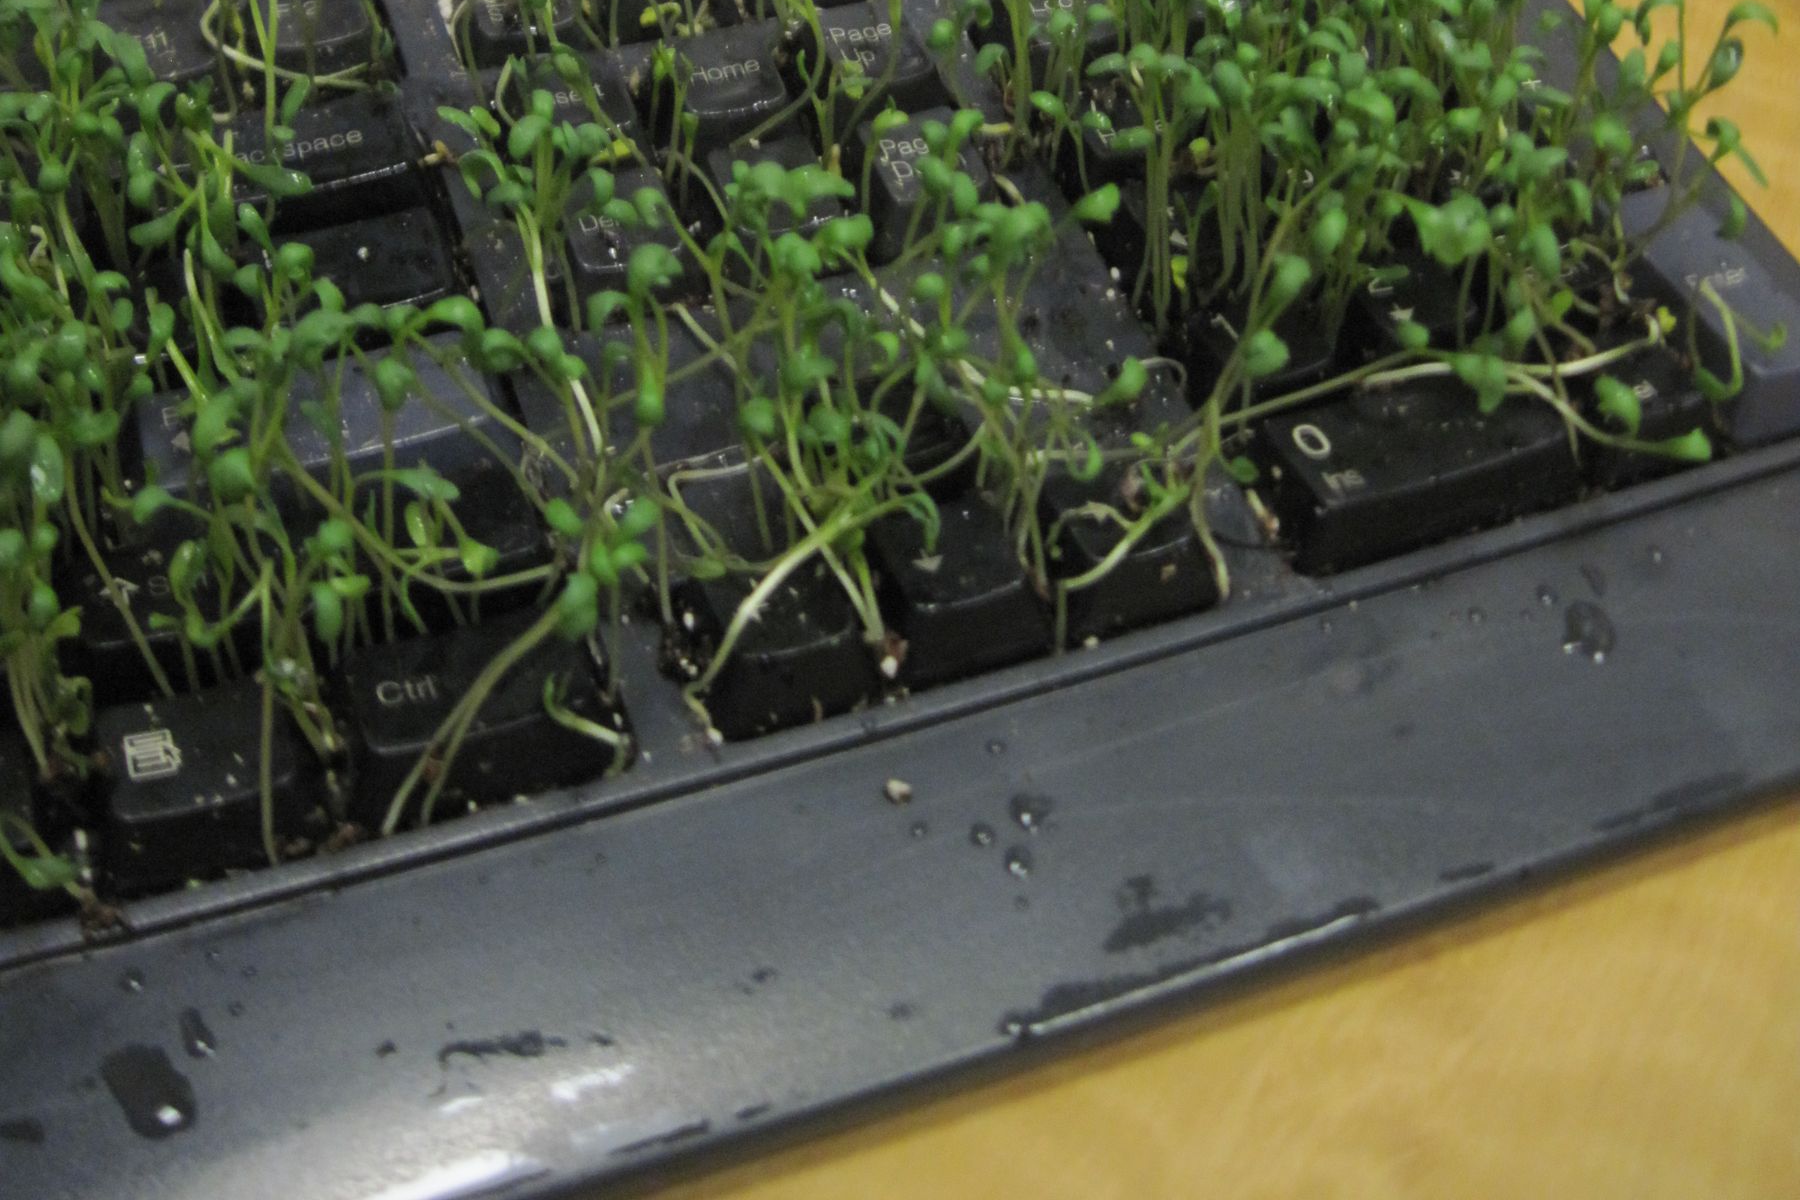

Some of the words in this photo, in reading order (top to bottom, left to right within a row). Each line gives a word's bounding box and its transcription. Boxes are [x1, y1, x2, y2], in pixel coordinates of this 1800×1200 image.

[828, 22, 893, 47] Page
[690, 58, 761, 87] Home
[230, 129, 364, 165] acspace
[879, 137, 938, 162] Pag
[1292, 423, 1332, 460] 0
[375, 674, 438, 705] Ctrl
